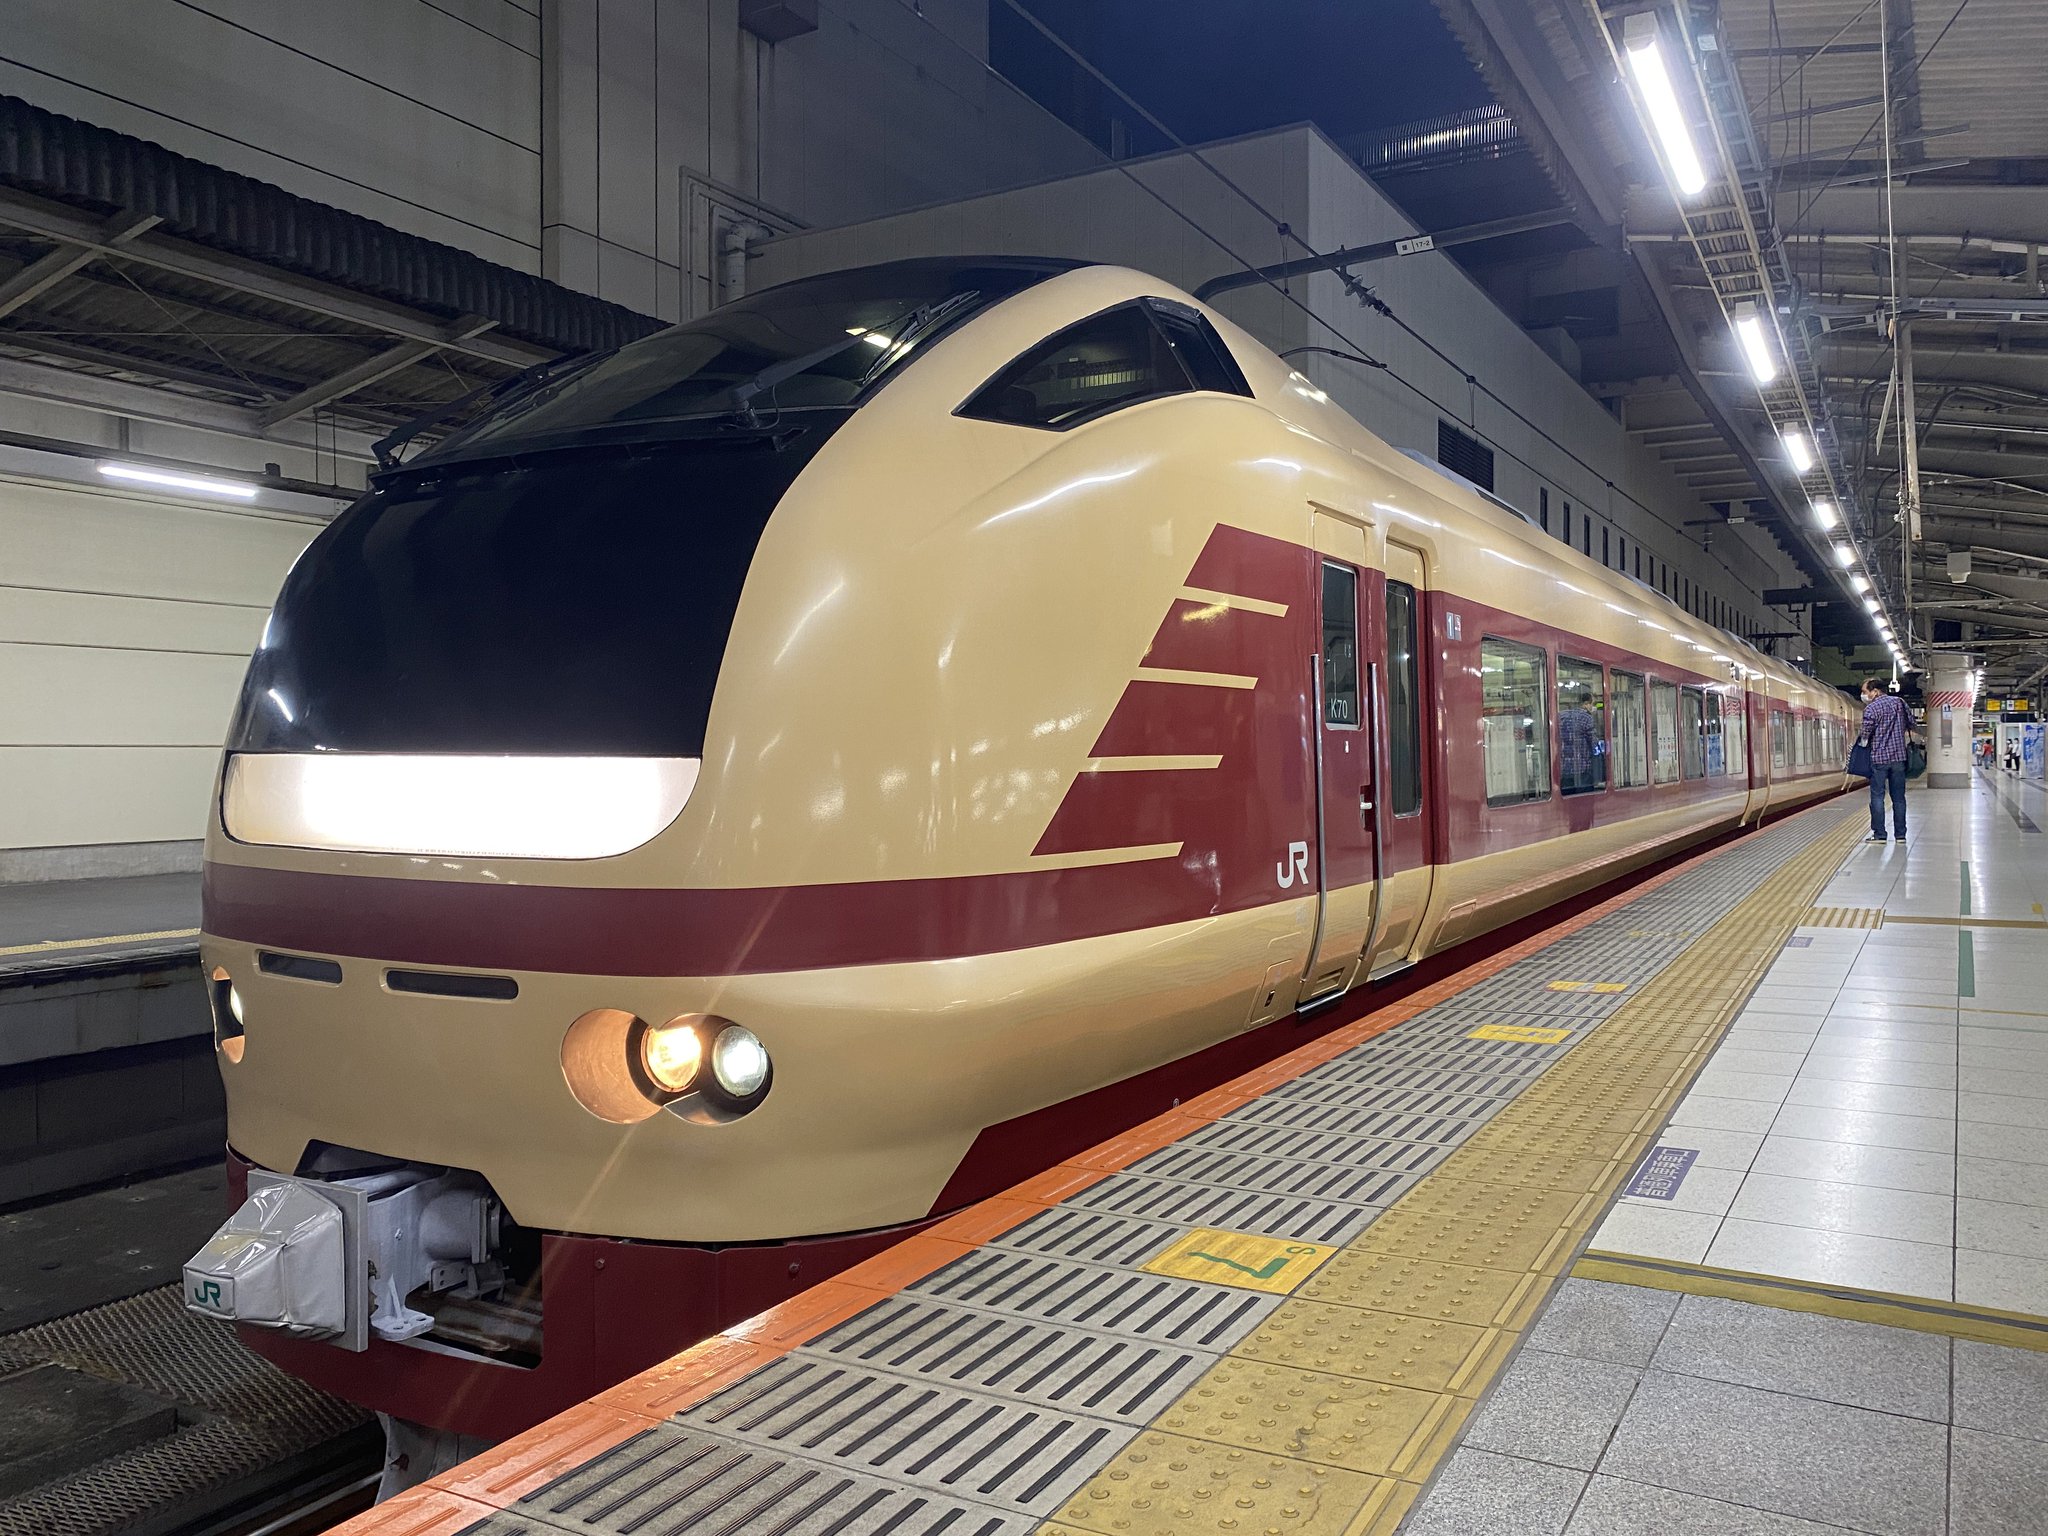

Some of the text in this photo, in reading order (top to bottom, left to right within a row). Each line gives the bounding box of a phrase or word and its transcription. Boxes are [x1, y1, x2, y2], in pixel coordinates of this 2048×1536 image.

[1416, 240, 1430, 248] 17-2
[1331, 698, 1347, 719] K70
[1277, 841, 1309, 888] JR
[194, 1280, 221, 1308] JR
